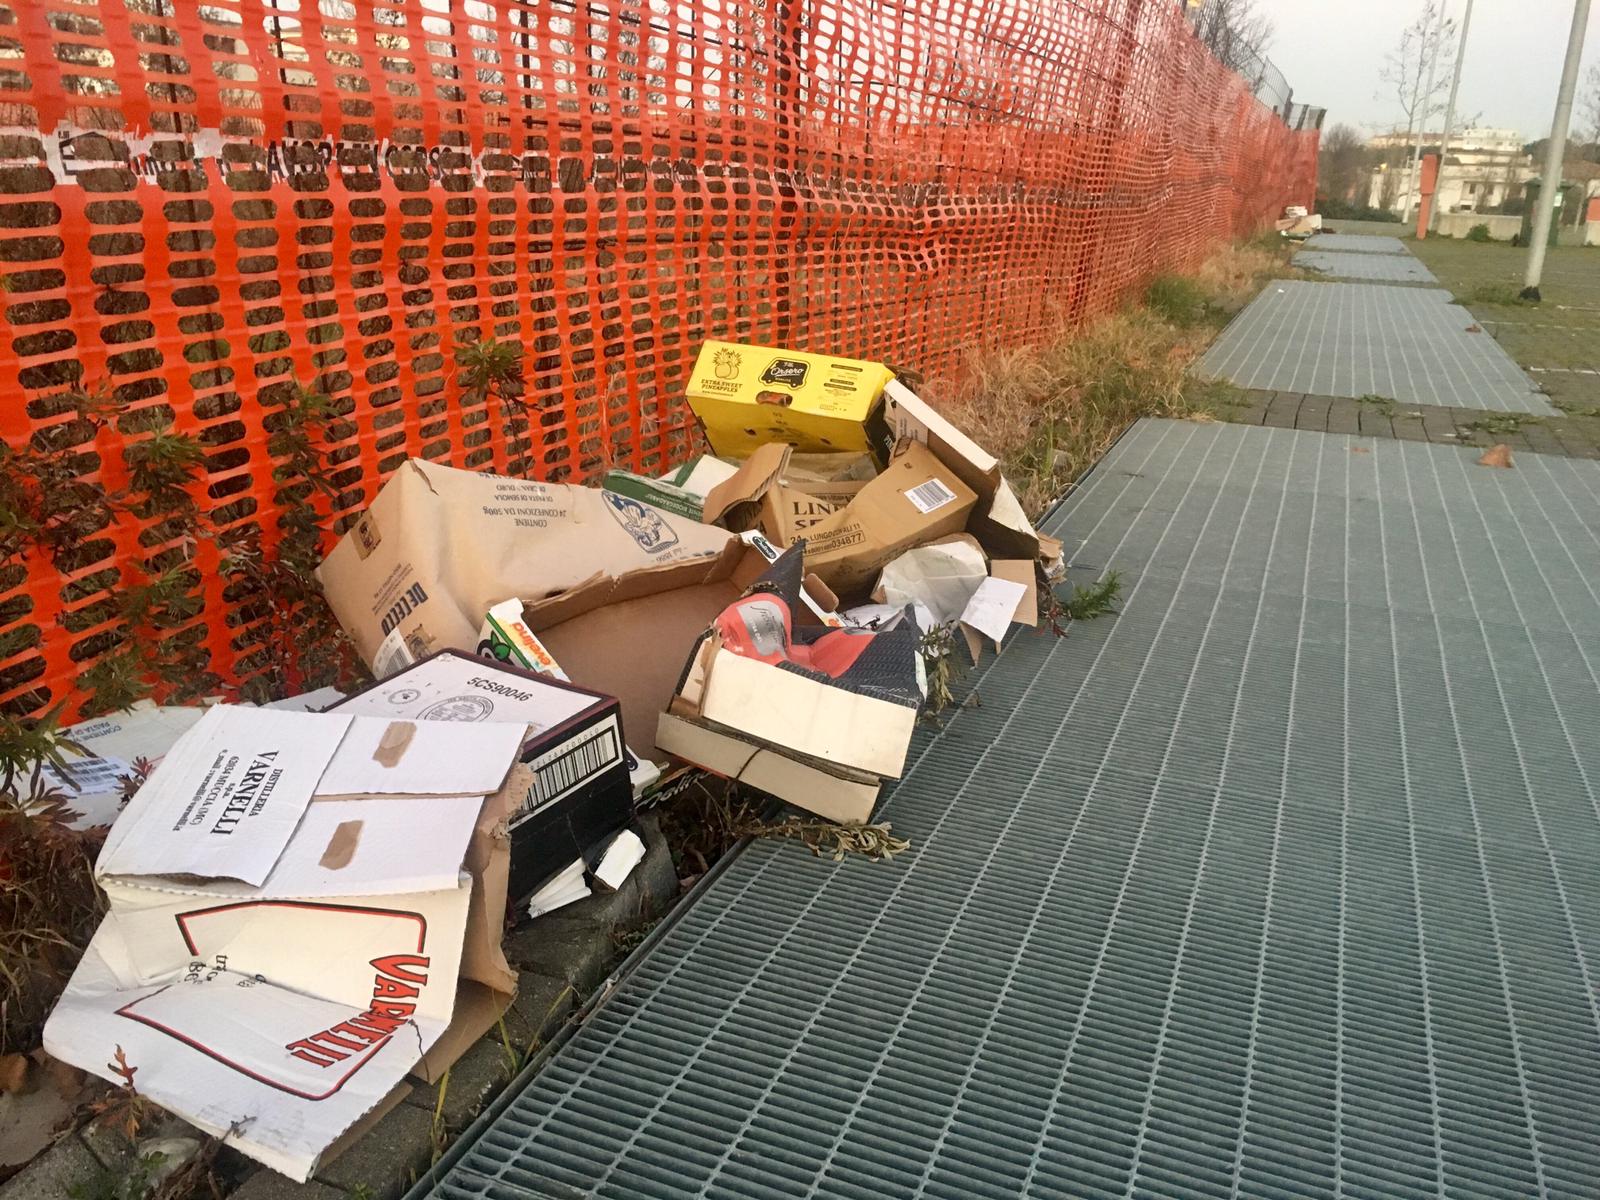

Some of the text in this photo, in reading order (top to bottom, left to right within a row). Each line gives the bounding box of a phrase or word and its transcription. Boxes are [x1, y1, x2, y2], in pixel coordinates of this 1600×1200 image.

[720, 382, 743, 391] SWEET
[494, 494, 520, 502] SEMOLA
[528, 495, 546, 503] PASTA
[503, 507, 516, 515] DA
[517, 508, 559, 518] CONFEZIONI
[514, 519, 548, 528] CONTIENE
[511, 621, 552, 667] evelina
[466, 677, 533, 703] 5CS90046
[203, 775, 229, 807] MUCCIA
[210, 750, 280, 835] VARNELLI
[248, 768, 283, 817] DISTILLERIA
[189, 806, 210, 826] (MC)
